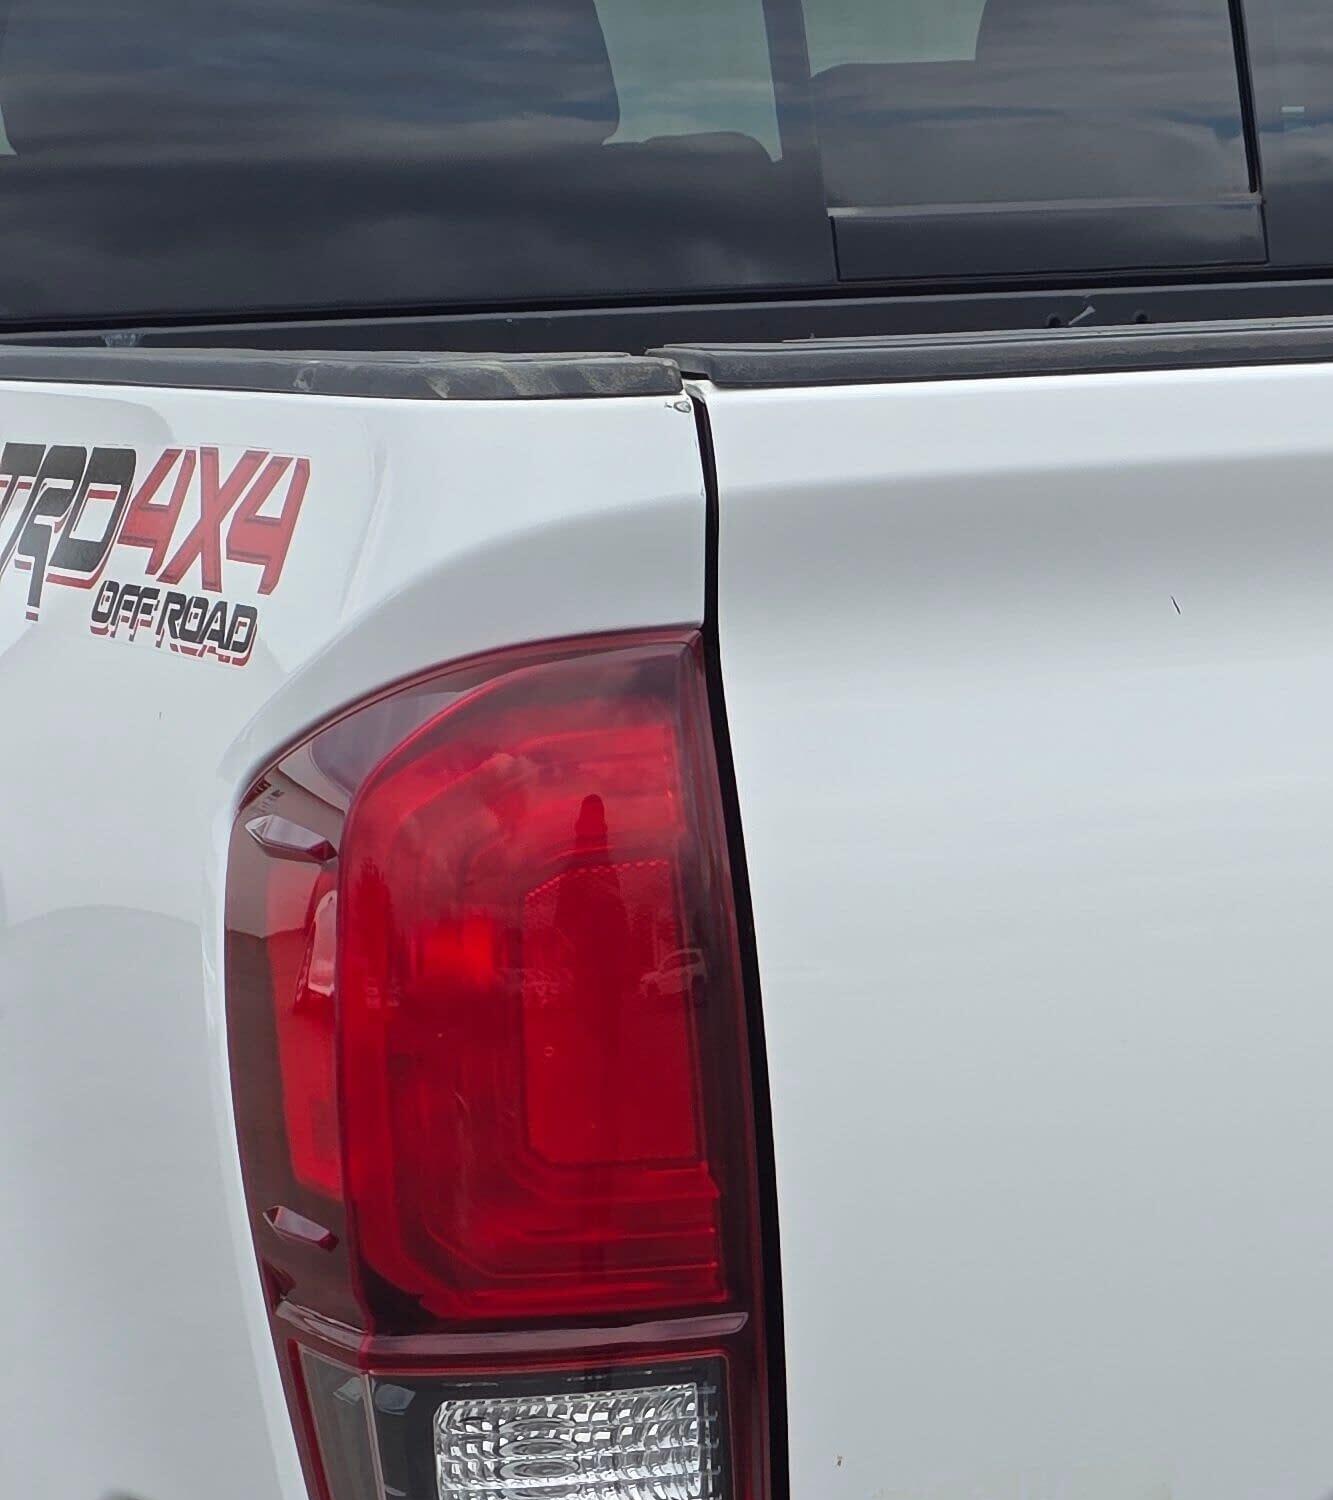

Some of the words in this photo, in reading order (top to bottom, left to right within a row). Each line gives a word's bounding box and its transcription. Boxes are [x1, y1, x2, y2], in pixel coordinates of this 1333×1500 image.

[0, 442, 137, 622] TRD
[117, 447, 311, 595] 4X4
[155, 591, 258, 666] ROAD
